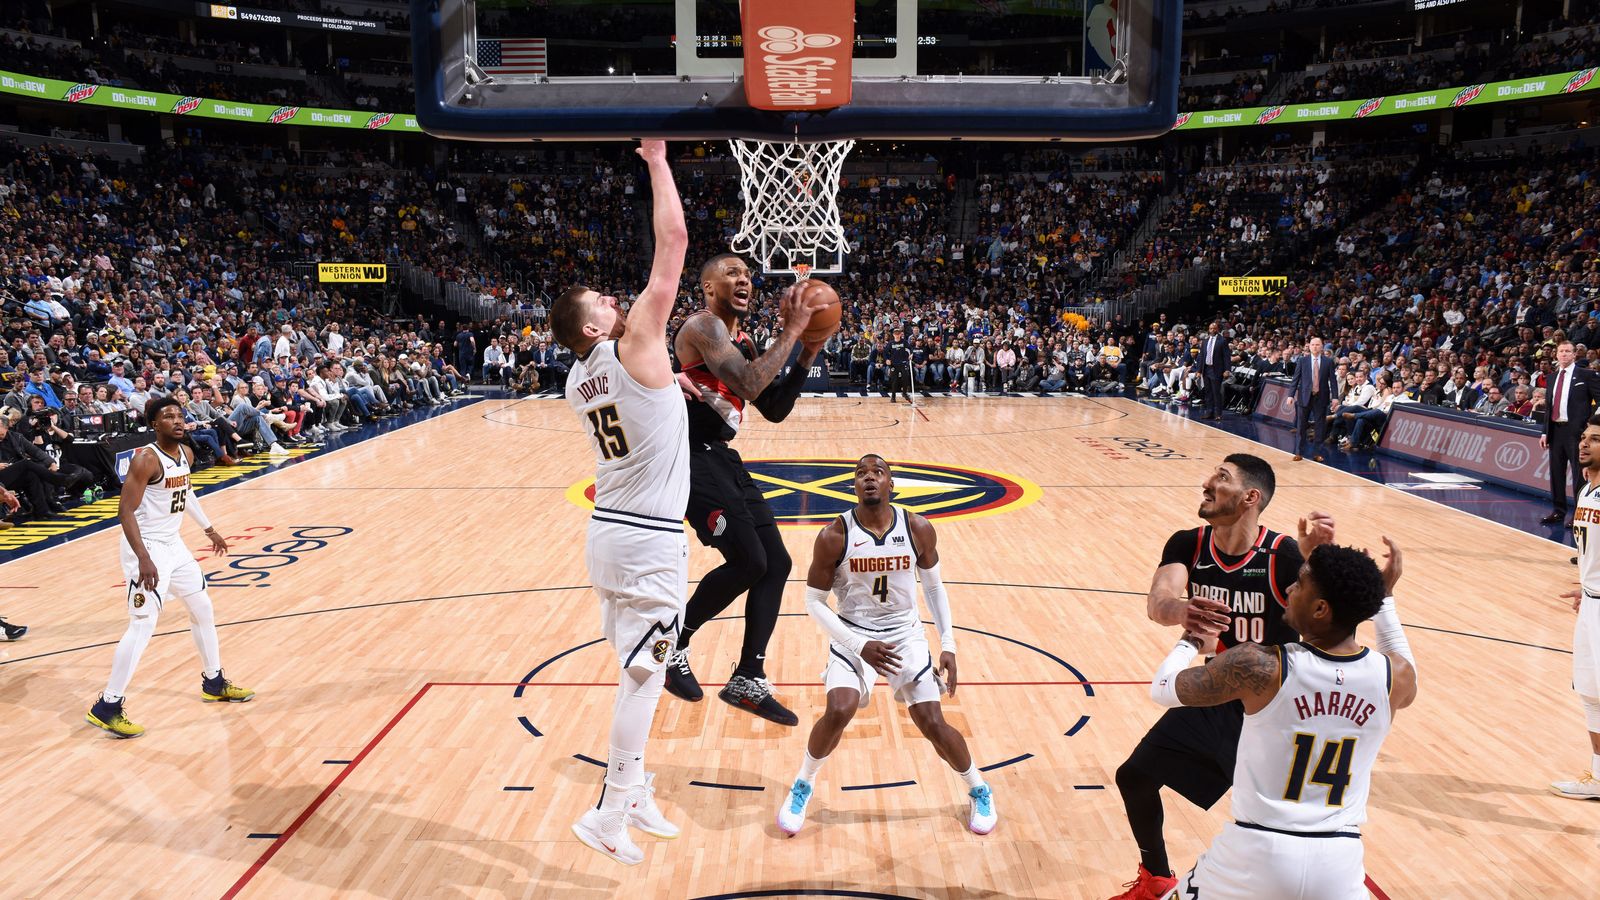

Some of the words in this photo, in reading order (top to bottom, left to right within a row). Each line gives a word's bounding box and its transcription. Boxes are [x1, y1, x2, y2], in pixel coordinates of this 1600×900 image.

[240, 12, 281, 23] 5496742003
[363, 267, 384, 279] WU
[586, 403, 631, 461] 15
[1390, 418, 1423, 448] 2020
[1421, 424, 1492, 464] TELLURIDE
[1498, 447, 1524, 466] KIA
[170, 489, 186, 514] 25
[204, 526, 353, 588] pepsi
[849, 555, 910, 573] NUGGETS
[872, 575, 888, 603] 4
[1235, 616, 1264, 643] 00
[1294, 691, 1376, 727] HARRIS
[1282, 731, 1359, 808] 14
